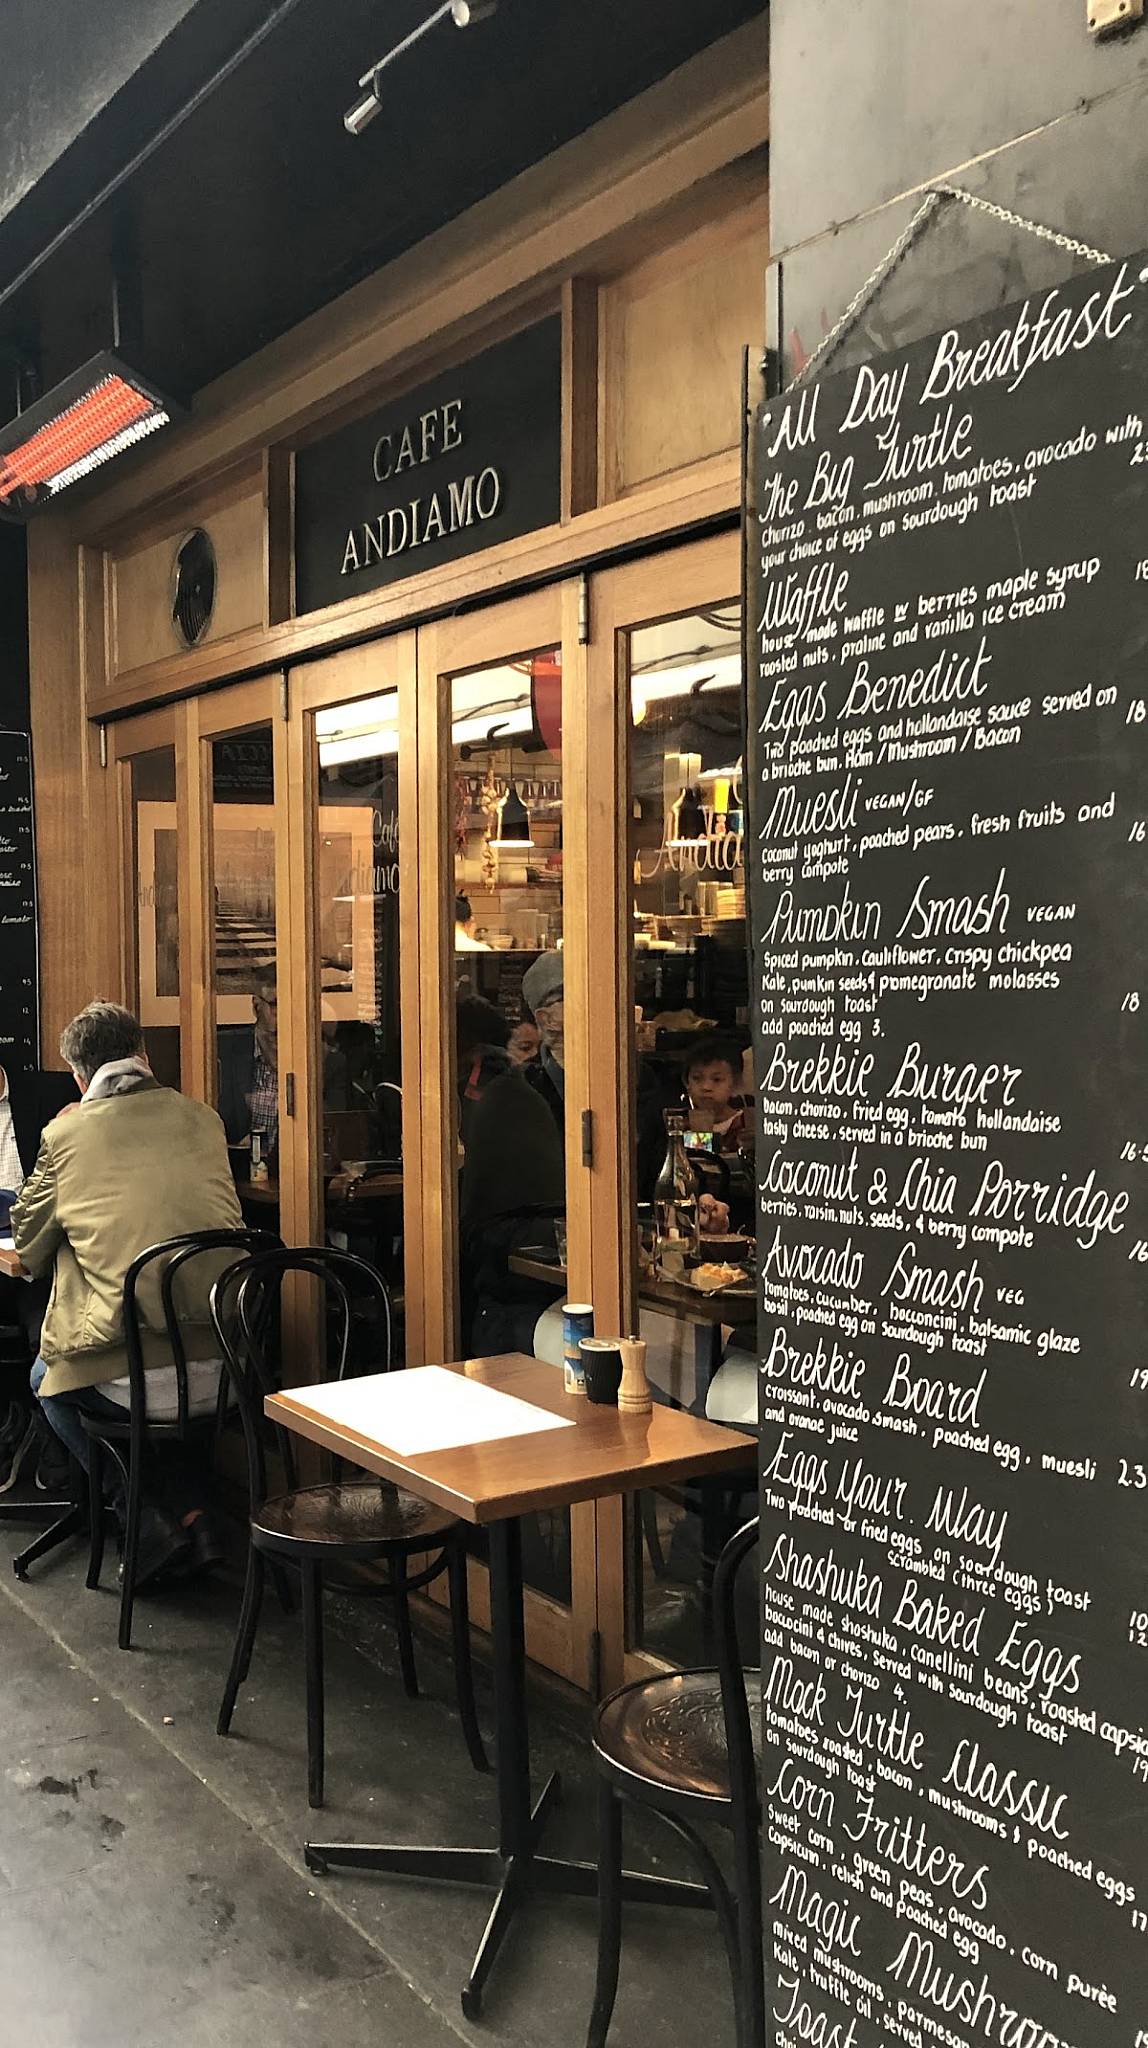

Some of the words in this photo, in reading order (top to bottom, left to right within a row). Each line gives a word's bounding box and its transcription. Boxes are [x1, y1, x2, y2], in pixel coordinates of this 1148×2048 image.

[767, 383, 820, 458] All
[839, 363, 909, 440] Day
[919, 263, 1135, 405] Breakfast
[373, 399, 463, 482] CAFE
[759, 472, 798, 523] The
[803, 451, 854, 512] Big
[863, 404, 973, 490] Turtle
[1024, 426, 1097, 470] avocado
[1106, 415, 1142, 443] with
[340, 466, 500, 575] ANDIAMO
[761, 550, 786, 578] your
[789, 538, 822, 562] choice
[826, 530, 838, 552] of
[843, 524, 872, 553] eggs
[880, 520, 895, 537] on
[990, 473, 1037, 507] toast
[757, 562, 850, 641] Waffle
[805, 616, 837, 643] made
[844, 607, 884, 634] waffle
[918, 586, 977, 618] berries
[987, 568, 1038, 601] maple
[1047, 558, 1100, 594] syrup
[841, 633, 886, 665] praline
[893, 622, 918, 647] and
[924, 609, 974, 639] vanilla
[983, 605, 1004, 626] ice
[1009, 589, 1065, 619] cream
[759, 678, 830, 749] Eggs
[837, 633, 992, 722] Benedict
[790, 726, 838, 763] poached
[843, 726, 872, 752] eggs
[878, 719, 903, 742] and
[906, 707, 981, 738] hollandaise
[988, 697, 1031, 723] sauce
[1042, 683, 1091, 715] served
[1096, 686, 1117, 706] on
[1126, 700, 1146, 724] 18
[772, 758, 811, 779] brioche
[759, 771, 862, 841] Muesli
[859, 825, 909, 858] poached
[971, 813, 1010, 835] fresh
[1018, 801, 1065, 829] fruits
[1078, 792, 1115, 822] and
[1128, 822, 1145, 841] 16
[763, 867, 793, 886] berry
[802, 854, 848, 882] compote
[896, 868, 1009, 939] Smash
[1028, 904, 1075, 922] VEGAN
[879, 967, 976, 1001] pomegranate
[989, 968, 1059, 989] molasses
[945, 948, 992, 971] crispy
[998, 939, 1071, 968] chickpea
[761, 999, 773, 1013] on
[781, 996, 834, 1020] sourdough
[845, 993, 878, 1012] toast
[762, 1018, 782, 1034] add
[789, 1017, 833, 1040] poached
[840, 1021, 861, 1042] egg
[1121, 992, 1139, 1012] 18
[760, 1042, 874, 1097] Brekkie
[886, 1042, 1022, 1117] Burger
[764, 1118, 788, 1144] tasty
[839, 1124, 876, 1143] served
[908, 1128, 953, 1149] brioche
[961, 1131, 987, 1151] bun
[853, 1100, 883, 1121] fried
[977, 1108, 1061, 1132] hollandaise
[759, 1146, 859, 1204] Coconut
[868, 1168, 887, 1205] &
[895, 1157, 957, 1214] Chia
[969, 1161, 1129, 1252] Porridge
[928, 1218, 966, 1249] berry
[972, 1225, 1033, 1252] compote
[1129, 1240, 1148, 1262] 16
[762, 1225, 864, 1292] Avocado
[881, 1242, 983, 1316] Smash
[997, 1288, 1024, 1305] VEG
[796, 1306, 835, 1326] poached
[839, 1314, 858, 1338] egg
[861, 1320, 875, 1334] on
[882, 1319, 944, 1353] sourdough
[952, 1333, 987, 1356] toast
[969, 1316, 1031, 1347] balsamic
[1037, 1328, 1080, 1356] glaze
[760, 1325, 867, 1402] Brekkie
[882, 1353, 987, 1431] Board
[1130, 1368, 1148, 1390] 19
[765, 1406, 784, 1422] and
[827, 1422, 858, 1444] juice
[933, 1428, 989, 1453] poached
[1042, 1455, 1096, 1480] muesli
[763, 1432, 831, 1509] Eggs
[835, 1459, 907, 1524] Your
[923, 1487, 1007, 1572] Way
[843, 1517, 857, 1532] or
[861, 1519, 888, 1542] fried
[890, 1532, 922, 1558] eggs
[934, 1548, 950, 1564] on
[1047, 1579, 1091, 1614] toast
[888, 1548, 946, 1581] scrambled
[764, 1532, 884, 1621] Shashuka
[891, 1576, 988, 1659] Baked
[995, 1621, 1081, 1703] Eggs
[1129, 1630, 1147, 1646] 12
[1130, 1611, 1148, 1630] 10
[765, 1629, 783, 1647] add
[791, 1638, 819, 1664] bacon
[825, 1657, 836, 1670] or
[841, 1661, 879, 1690] chorizo
[766, 1583, 794, 1610] house
[803, 1604, 833, 1627] made
[1040, 1701, 1096, 1736] roasted
[873, 1648, 911, 1679] served
[918, 1672, 943, 1693] with
[949, 1681, 1019, 1728] sourdough
[1027, 1711, 1069, 1745] toast
[764, 1654, 827, 1728] Mock
[836, 1683, 924, 1771] Turtle
[942, 1739, 1069, 1842] Classic
[767, 1729, 779, 1745] on
[786, 1736, 841, 1779] sourdough
[847, 1764, 876, 1792] toast
[1133, 1757, 1148, 1782] 19
[766, 1702, 820, 1746] tomatoes
[929, 1787, 1008, 1838] mushrooms
[1028, 1839, 1092, 1880] poached
[1096, 1871, 1135, 1906] eggs
[767, 1756, 837, 1829] Corn
[840, 1789, 992, 1913] Fritters
[769, 1804, 801, 1834] sweet
[852, 1853, 890, 1889] green
[1022, 1947, 1057, 1980] corn
[769, 1863, 863, 1960] Magic
[832, 1863, 865, 1892] relish
[871, 1886, 893, 1908] and
[896, 1898, 947, 1939] poached
[953, 1931, 979, 1964] egg
[1132, 1910, 1147, 1931] 17
[773, 1921, 807, 1955] mixed
[810, 1962, 852, 2005] truffle
